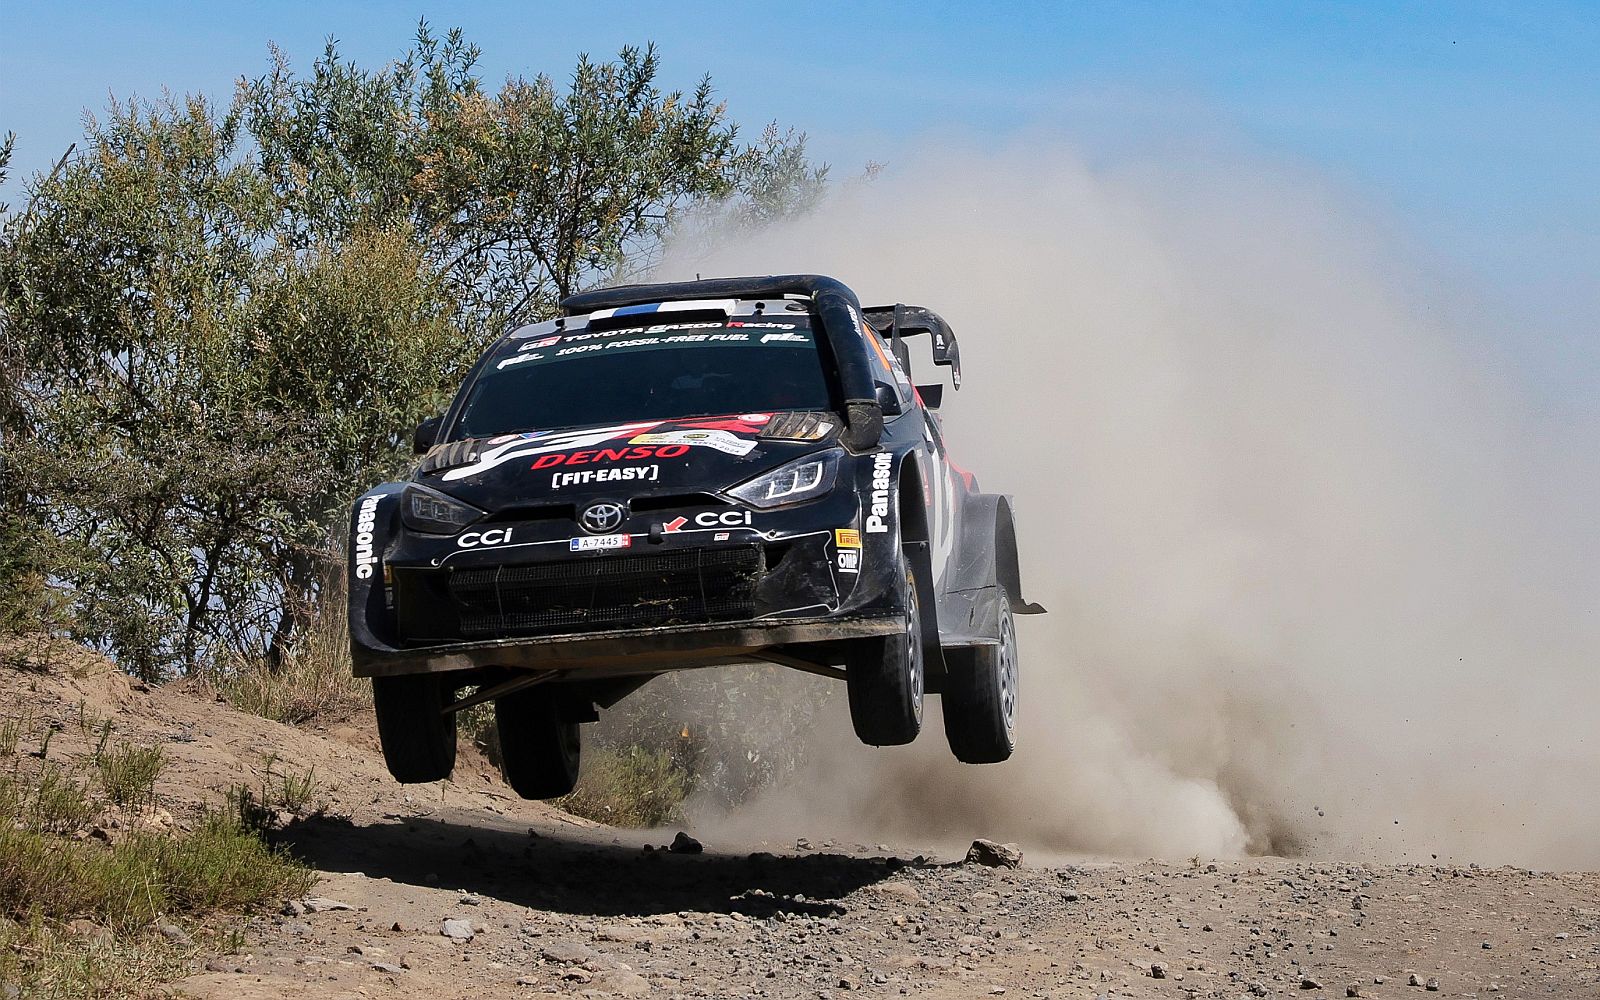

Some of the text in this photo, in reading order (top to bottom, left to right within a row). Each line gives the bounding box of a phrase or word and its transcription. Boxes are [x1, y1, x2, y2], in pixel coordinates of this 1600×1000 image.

[564, 327, 643, 342] TOYOTA
[726, 321, 796, 330] Racing
[556, 333, 750, 356] 100% FOSSIL-FREE FUEL
[531, 445, 691, 470] DENSO
[582, 537, 619, 548] A-7445
[837, 552, 858, 569] OMP
